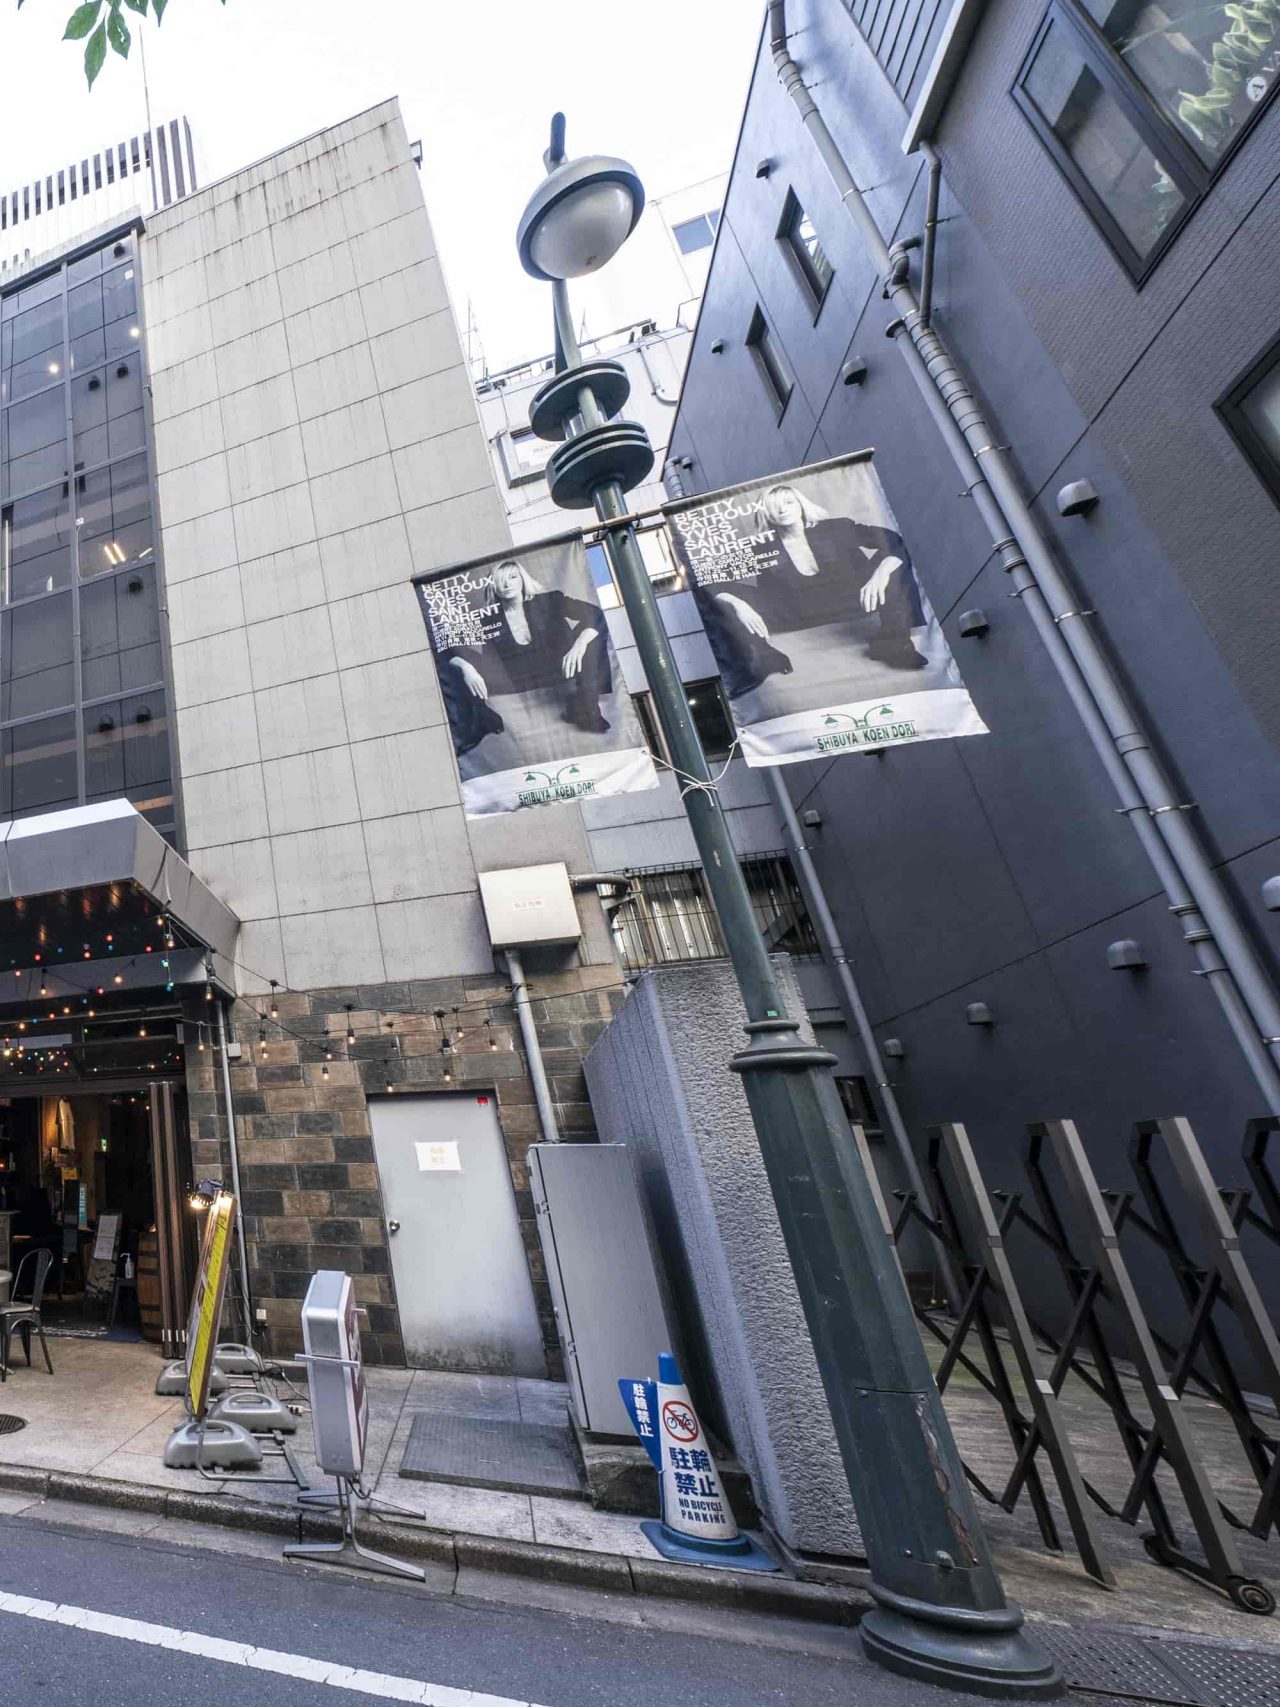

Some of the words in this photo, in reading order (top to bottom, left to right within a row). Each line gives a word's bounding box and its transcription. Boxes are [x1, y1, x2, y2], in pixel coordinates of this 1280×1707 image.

[673, 498, 735, 523] BETTY
[677, 500, 764, 531] CATROUX
[680, 521, 732, 540] YVES
[684, 529, 738, 550] SAINT
[686, 530, 776, 560] LAURENT
[421, 572, 470, 592] BETTY
[423, 575, 495, 599] CATROUX
[426, 594, 467, 608] YVES
[428, 601, 471, 617] SAINT
[430, 603, 500, 627] LAURENT
[817, 732, 858, 750] SHIBUYA
[863, 727, 891, 742] KOEN
[891, 723, 916, 738] DORI
[518, 789, 551, 805] SHIBUYA
[555, 785, 576, 798] KOEN
[577, 782, 596, 794] DORI
[632, 1383, 654, 1438] 駐輪禁止
[669, 1447, 713, 1473] 駐輪
[674, 1472, 719, 1497] 禁止
[679, 1497, 690, 1508] NO
[691, 1498, 723, 1511] BICYCLE
[681, 1509, 726, 1524] PARKING
